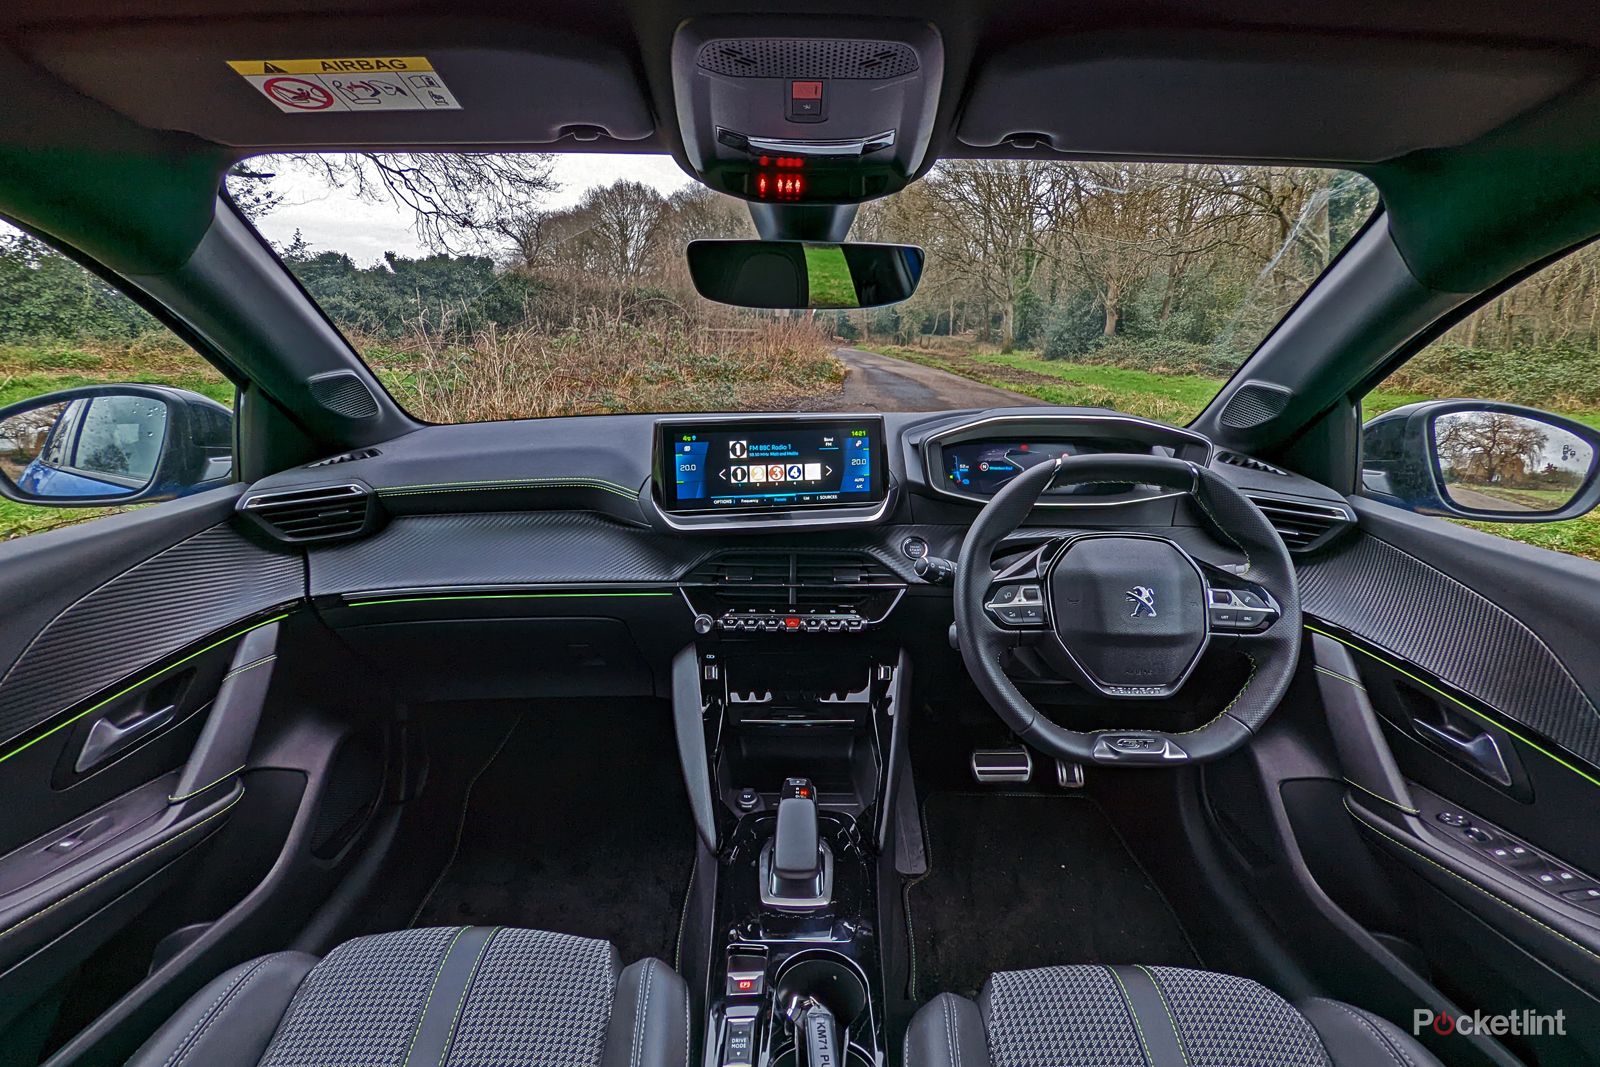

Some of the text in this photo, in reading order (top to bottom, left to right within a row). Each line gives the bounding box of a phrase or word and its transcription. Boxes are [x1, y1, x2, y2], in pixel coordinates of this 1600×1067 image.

[320, 58, 408, 72] AIRBAG
[680, 464, 697, 472] 20.0
[771, 467, 782, 480] 3
[789, 466, 799, 478] 4
[1109, 686, 1162, 694] PEUGEOT
[1117, 738, 1155, 749] GT
[816, 1022, 828, 1050] KM71
